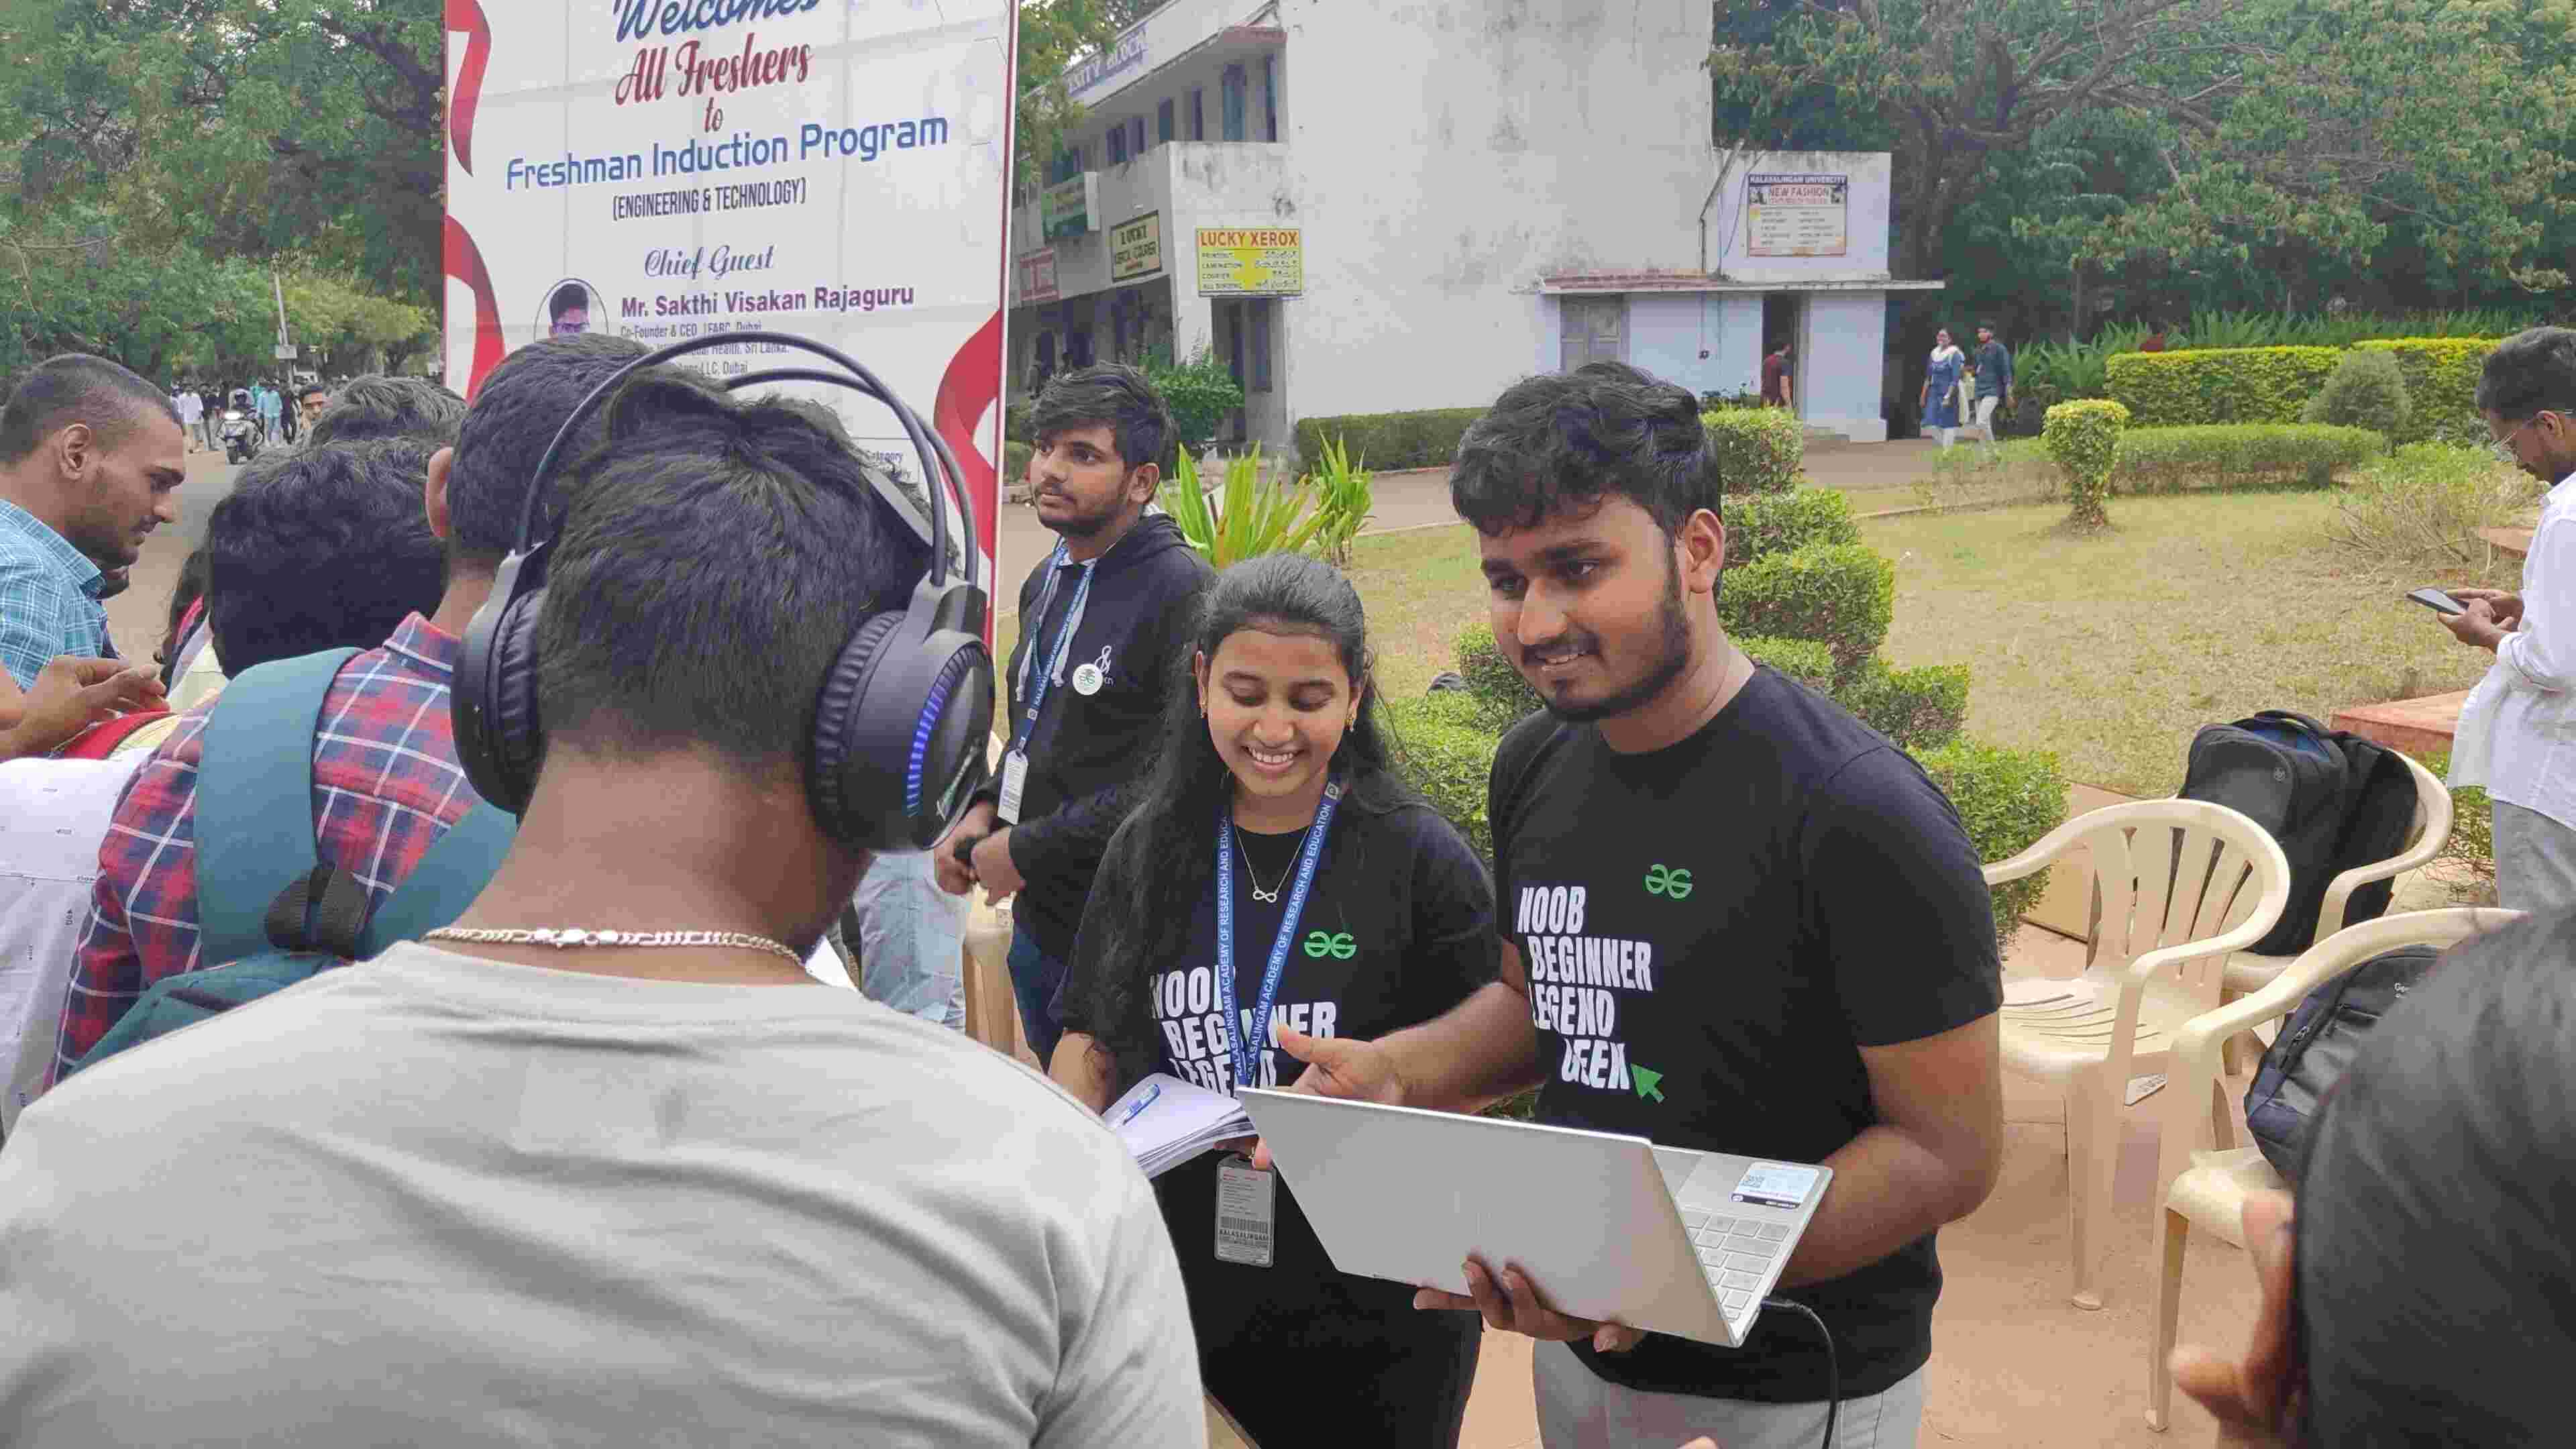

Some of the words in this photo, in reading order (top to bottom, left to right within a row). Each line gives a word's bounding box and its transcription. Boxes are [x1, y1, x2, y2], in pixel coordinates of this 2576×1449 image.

[615, 46, 668, 105] All
[676, 33, 814, 97] Freshers
[704, 97, 724, 133] to
[506, 152, 642, 191] Freshman
[653, 131, 788, 176] Induction
[800, 117, 948, 162] Program
[613, 190, 699, 221] (ENGINEERING
[702, 189, 711, 212] &
[715, 176, 806, 211] TECHNOLOGY)
[1791, 187, 1829, 197] FASHION
[644, 247, 704, 280] Chief
[708, 244, 775, 280] Guest
[1201, 231, 1246, 247] LUCKY
[1250, 231, 1299, 247] XEROX
[621, 297, 649, 318] Mr.
[655, 292, 718, 317] Sakthi
[725, 290, 807, 313] Visakan
[814, 284, 914, 313] Rajaguru
[621, 325, 667, 339] Co-Founder
[1220, 851, 1230, 871] AND
[1220, 874, 1230, 925] RESEARCH
[1517, 886, 1586, 934] NOOB
[1220, 926, 1230, 941] OF
[1248, 1000, 1269, 1079] KALASALINGAM
[1265, 950, 1283, 1000] ACADEMY
[1277, 933, 1288, 949] OF
[1283, 878, 1305, 932] RESEARCH
[1301, 858, 1313, 880] AND
[1307, 804, 1332, 856] EDUCATION
[1220, 943, 1230, 993] ACADEMY
[1527, 936, 1653, 992] BEGINNER
[1162, 1002, 1336, 1061] BEGNER
[1223, 996, 1243, 1077] KALASALINGAM
[1169, 1050, 1277, 1099] EGED
